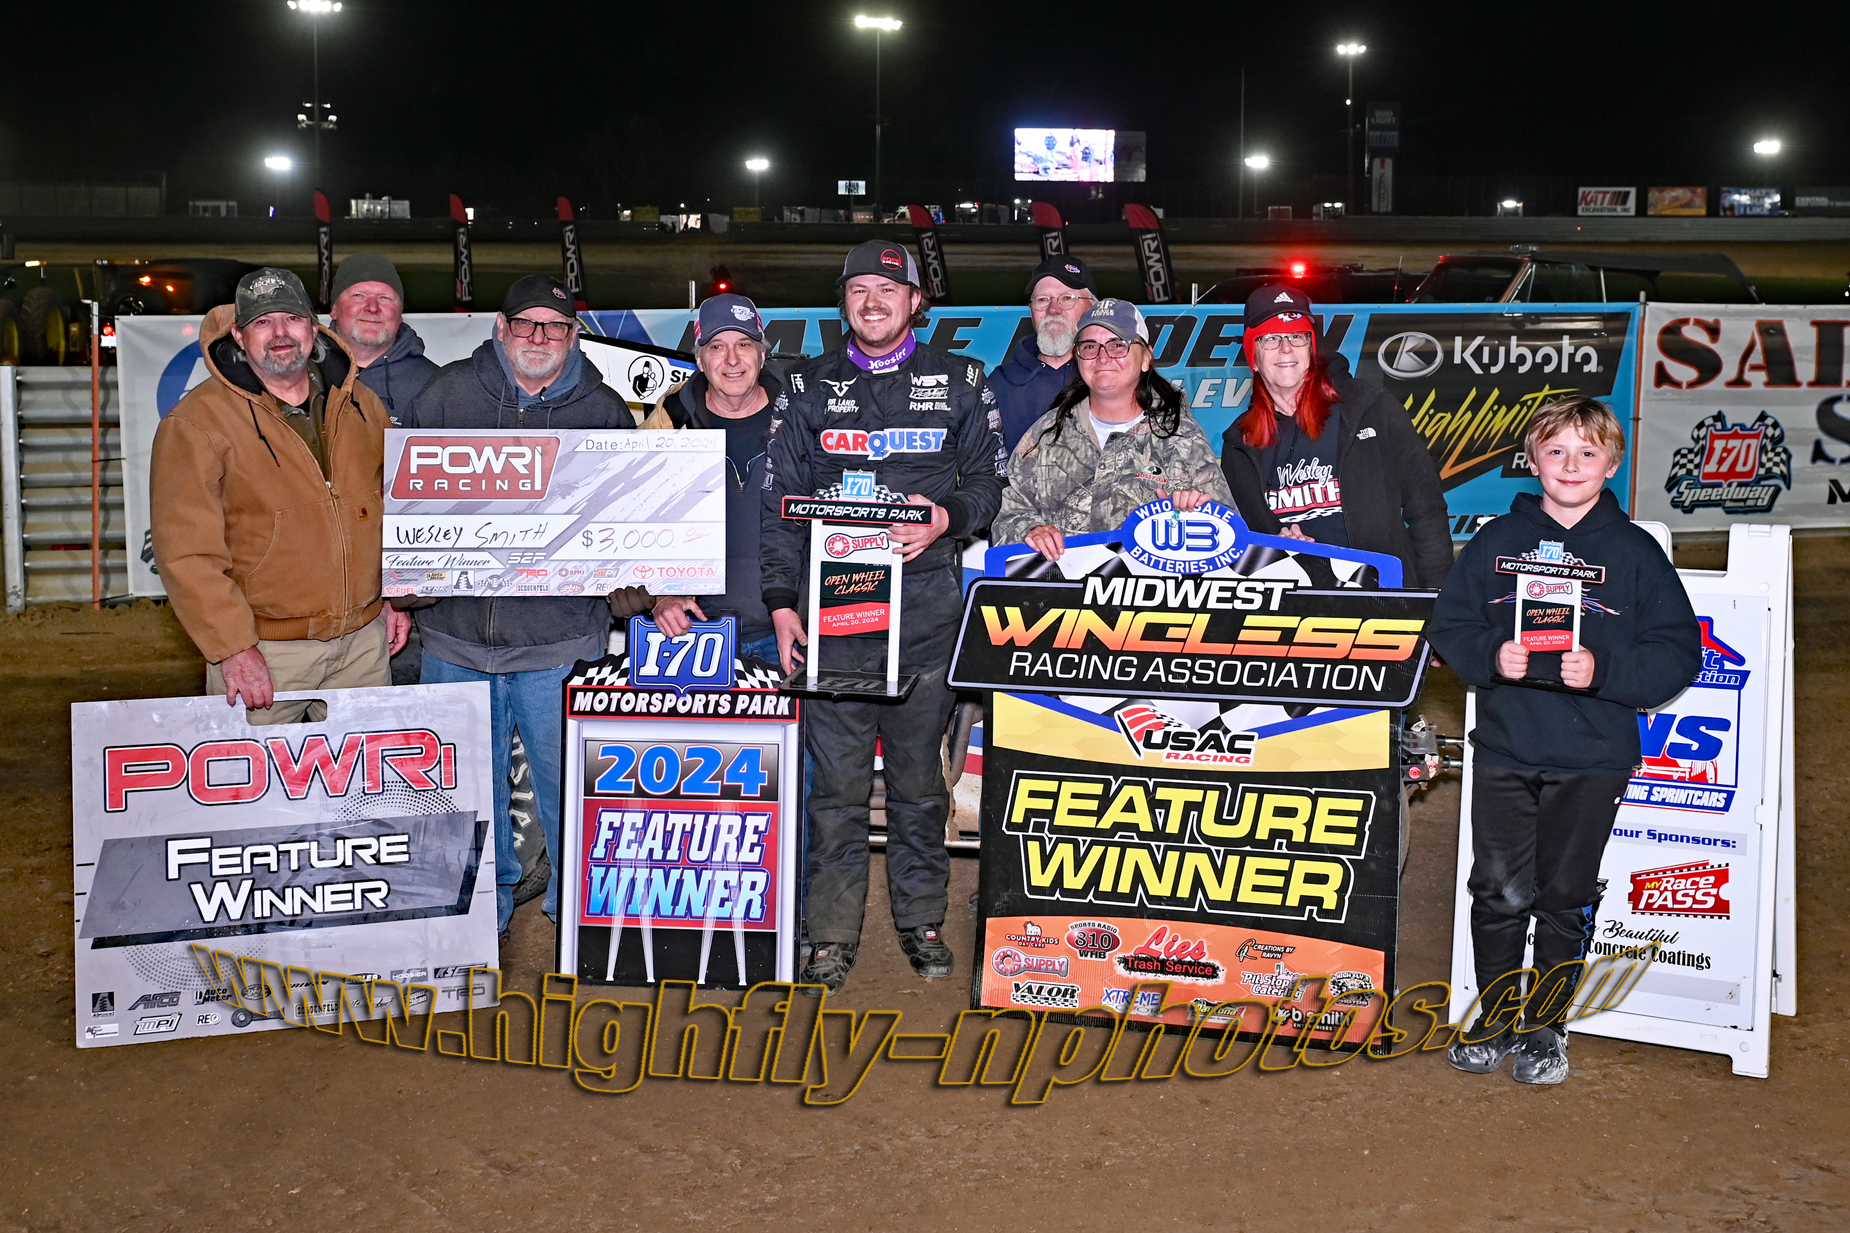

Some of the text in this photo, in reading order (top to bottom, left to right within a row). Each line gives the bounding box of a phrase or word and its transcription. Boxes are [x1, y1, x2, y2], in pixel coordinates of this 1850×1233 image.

[1579, 190, 1610, 206] KAT
[1453, 335, 1598, 374] Kubota
[827, 405, 859, 413] PROPERTY
[909, 401, 934, 411] RHR
[585, 438, 624, 451] Date:
[625, 436, 649, 453] April
[680, 435, 717, 449] 2024
[821, 430, 945, 461] CARQUEST
[1703, 438, 1759, 473] I-70
[1277, 457, 1333, 489] Wesley
[409, 478, 532, 491] RACING
[845, 477, 871, 495] I-70
[1674, 480, 1776, 506] Speedway
[1265, 480, 1340, 510] SMITH
[788, 503, 926, 522] MOTORSPORTS PARK
[851, 535, 885, 550] SUPPLY
[386, 552, 490, 569] Feature Winner
[1130, 545, 1244, 574] BATTERIES, INC.
[1540, 545, 1561, 559] I-70
[516, 569, 548, 578] TRD
[657, 567, 716, 578] TOYOTA
[824, 569, 886, 587] OPEN WHEEL
[1500, 561, 1598, 579] MOTORSPORTS PARK
[834, 581, 878, 595] CLASSIC
[1082, 578, 1284, 611] MIDWEST
[1546, 584, 1570, 593] SUPPLY
[822, 609, 885, 623] FEATURE WINNER
[862, 616, 879, 624] 2024
[1526, 607, 1570, 617] OPEN WHEEL
[980, 605, 1426, 661] WINGLESS
[638, 632, 725, 678] I-70
[1009, 651, 1386, 692] RACING ASSOCIATION
[572, 690, 791, 716] MOTORSPORTS PARK
[1142, 729, 1257, 755] USAC
[1165, 752, 1252, 764] RACING
[594, 743, 769, 797] 2024
[1650, 786, 1728, 808] SPRINTCARS
[1009, 778, 1364, 847] FEATURE
[590, 809, 772, 864] FEATURE
[1646, 828, 1737, 849] Sponsors:
[1025, 839, 1345, 911] WINNER
[1645, 875, 1715, 891] MY Race
[586, 865, 770, 922] WINNER
[1638, 887, 1718, 909] PASS
[1070, 922, 1118, 934] SPORTS RADIO
[1602, 919, 1680, 945] Beautiful
[1005, 933, 1060, 945] COUNTRY KIDS
[1074, 931, 1113, 950] 810
[1134, 925, 1207, 961] Lies
[1078, 949, 1107, 960] WHB
[1253, 944, 1285, 953] CREATIONS
[1261, 951, 1282, 959] RAVYN
[1650, 943, 1711, 971] Coatings
[1023, 957, 1066, 973] SUPPLY
[1126, 956, 1213, 977] Trash Service
[392, 971, 427, 980] HOOSIER
[1242, 972, 1290, 990] Pit Stop
[204, 988, 228, 997] Auto
[1013, 982, 1080, 999] VALOR
[1103, 988, 1161, 1006] XTREME
[1251, 984, 1304, 1002] Catering
